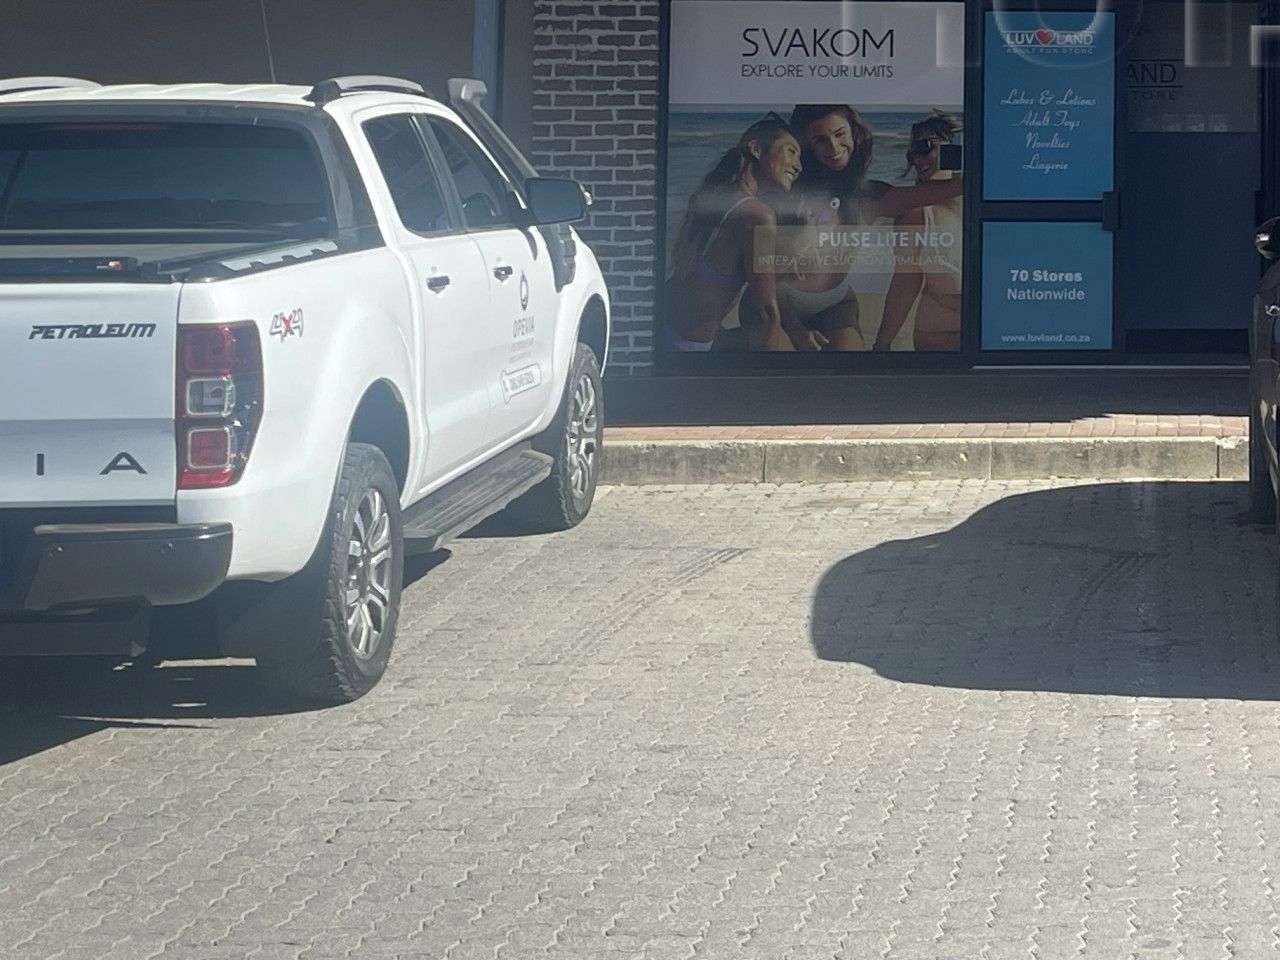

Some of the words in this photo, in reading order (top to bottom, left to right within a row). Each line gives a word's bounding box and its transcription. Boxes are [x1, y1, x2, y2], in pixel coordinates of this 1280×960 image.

[742, 28, 894, 58] SVAKOM
[1006, 33, 1034, 44] LUV
[1056, 33, 1094, 45] LAND
[741, 64, 804, 77] EXPLORE
[808, 65, 848, 77] YOUR
[853, 65, 894, 77] LIMITS
[1000, 88, 1034, 105] Lubes
[1039, 89, 1054, 105] &
[1055, 89, 1096, 106] Lotions
[1010, 110, 1050, 126] Adult
[1054, 110, 1080, 131] Toys
[1025, 132, 1070, 149] Novelties
[1022, 153, 1068, 174] Lingerie
[819, 232, 870, 247] PULSE
[876, 232, 909, 247] LITE
[915, 232, 954, 247] NEO
[1010, 270, 1029, 282] 70
[1032, 270, 1083, 282] Stores
[1007, 288, 1085, 300] Nationwide
[29, 323, 156, 340] PETROLEUM
[1001, 334, 1090, 342] www.luvland.co.za
